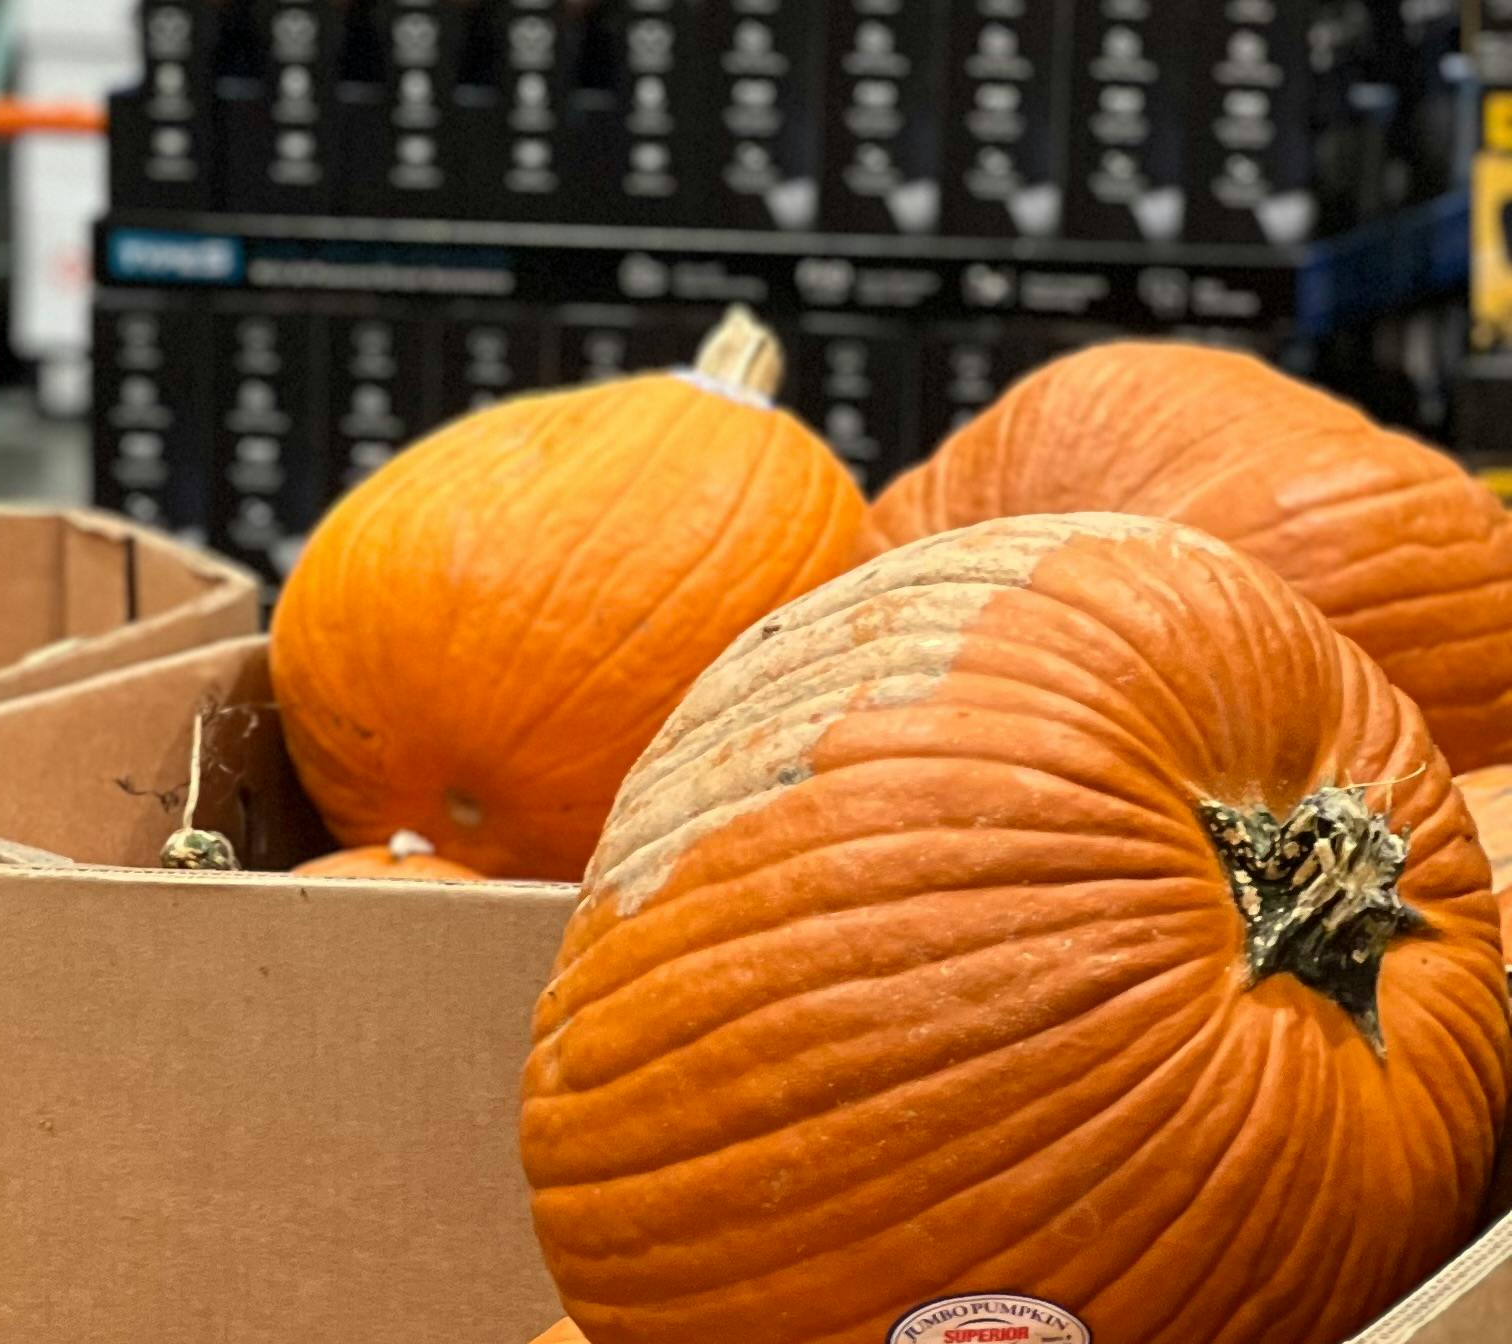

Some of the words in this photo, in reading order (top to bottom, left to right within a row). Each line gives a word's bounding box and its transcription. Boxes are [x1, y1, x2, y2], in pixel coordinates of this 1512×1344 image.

[903, 1305, 968, 1344] JUMBO
[971, 1301, 1070, 1331] PUMPKIN
[943, 1325, 1029, 1344] SUPERIOR
